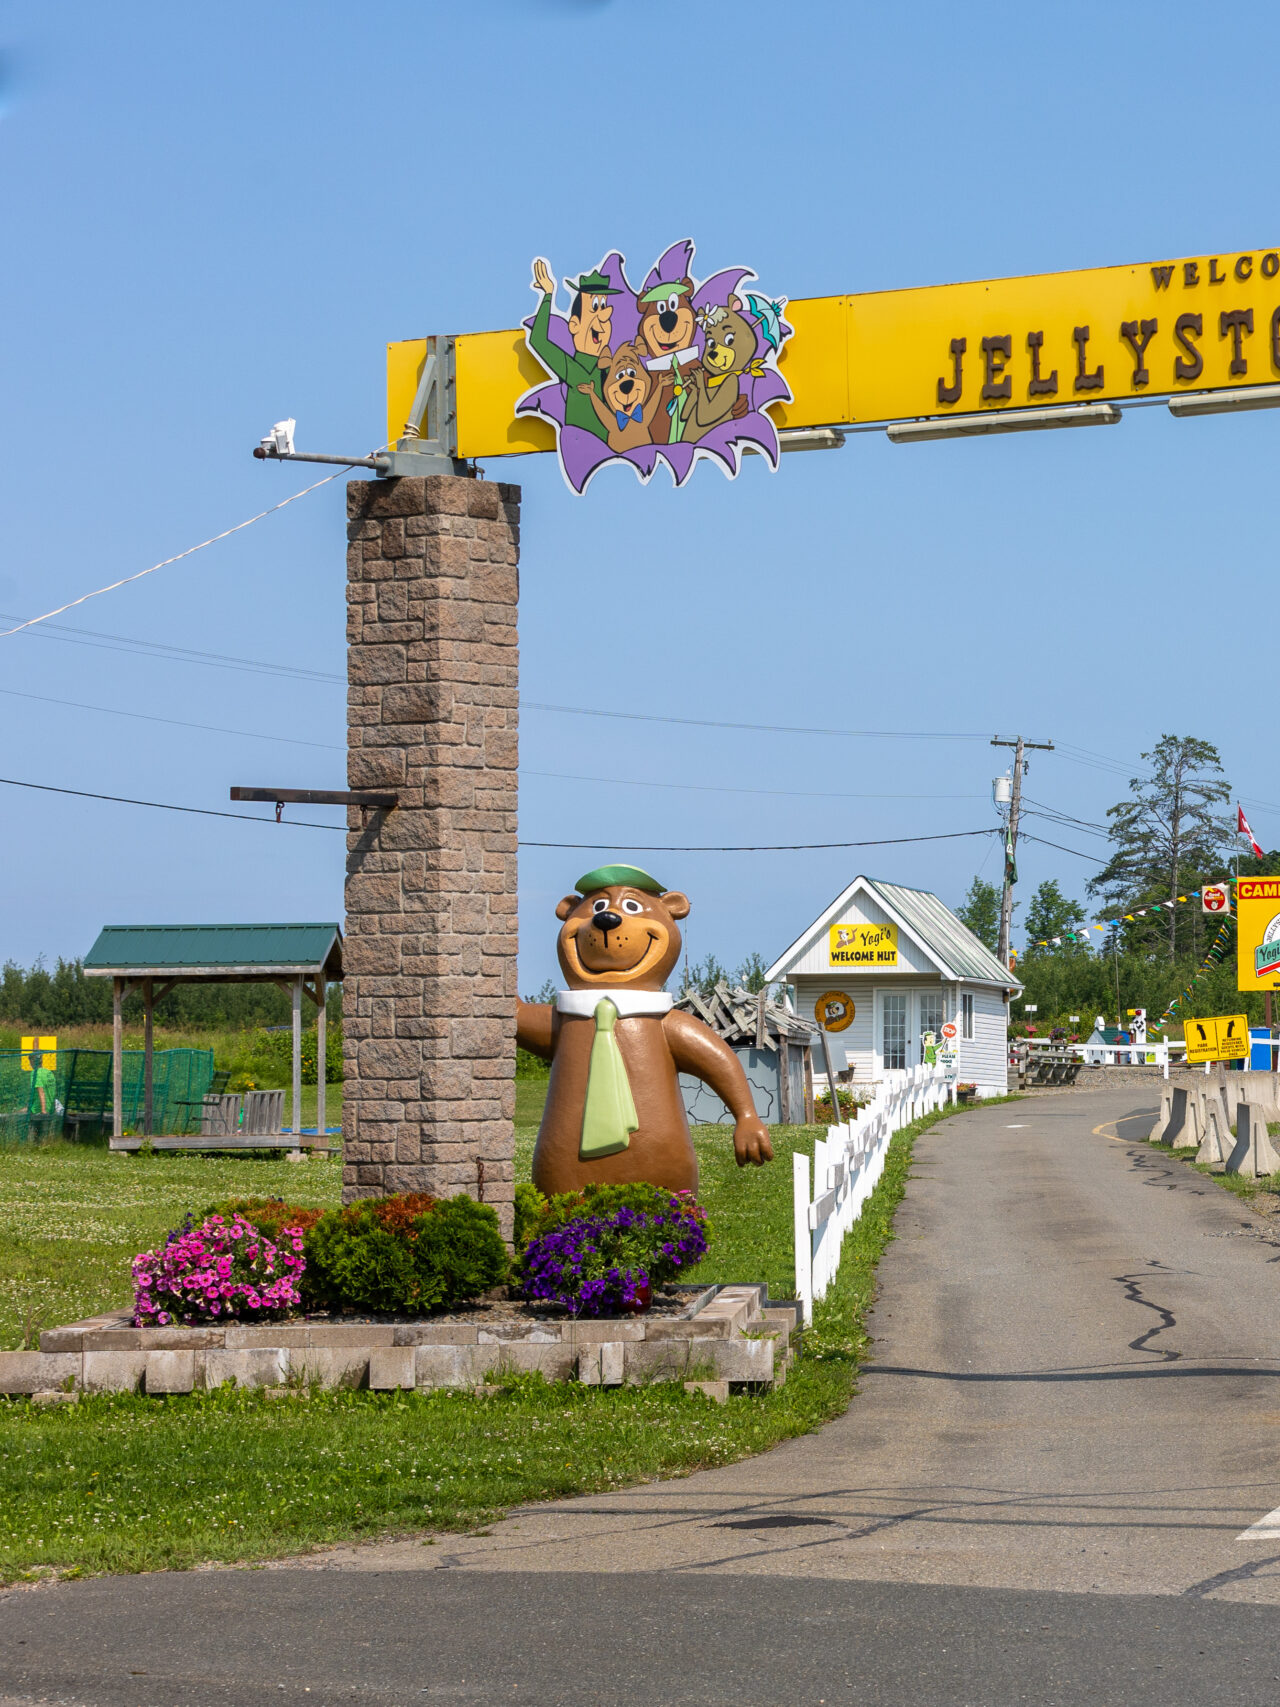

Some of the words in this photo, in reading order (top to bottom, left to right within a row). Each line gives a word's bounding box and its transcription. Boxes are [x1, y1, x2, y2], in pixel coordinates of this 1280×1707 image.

[860, 927, 892, 947] Yogi's
[831, 951, 875, 962] WELCOME
[877, 951, 896, 961] HUT
[1260, 943, 1280, 962] Yogi
